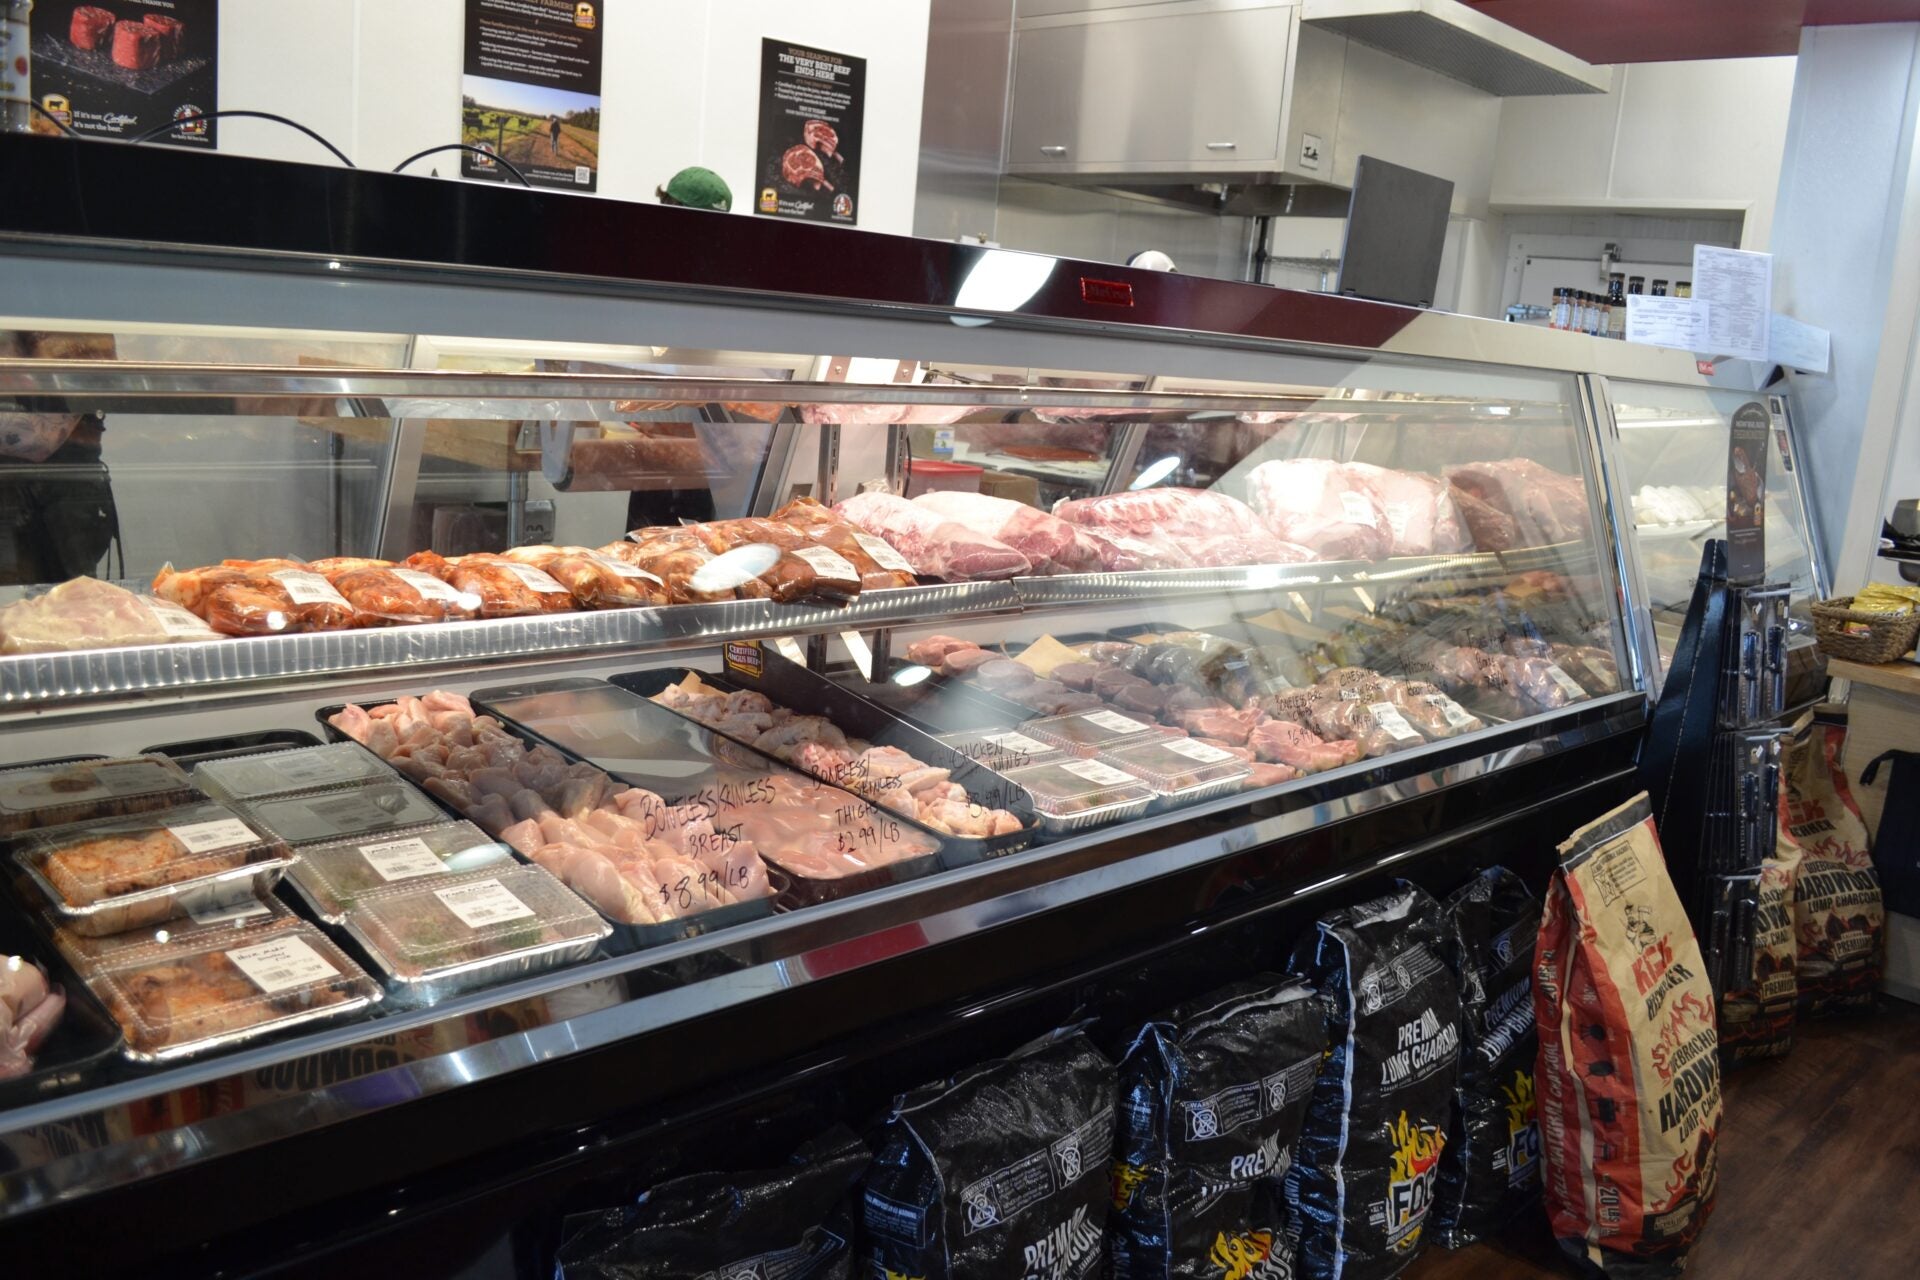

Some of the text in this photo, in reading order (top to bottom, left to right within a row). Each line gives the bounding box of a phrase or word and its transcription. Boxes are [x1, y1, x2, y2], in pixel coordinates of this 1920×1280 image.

[778, 53, 851, 75] THE VERY BEST BEEF
[788, 48, 843, 65] YOUR SEARCH FOR
[795, 66, 835, 80] ENDS HERE
[728, 652, 746, 664] ANGUS
[729, 645, 758, 656] CERTIFIED
[952, 738, 1003, 768] CHICKEN
[854, 774, 903, 797] SKINLESS
[689, 823, 744, 860] BREAST
[659, 861, 749, 909] $8.99/LB
[1808, 897, 1833, 914] LUMP
[1836, 937, 1872, 954] PREMIUM
[1380, 1051, 1411, 1086] LUMP
[1679, 1108, 1699, 1144] LUMP
[1598, 1185, 1619, 1205] 20
